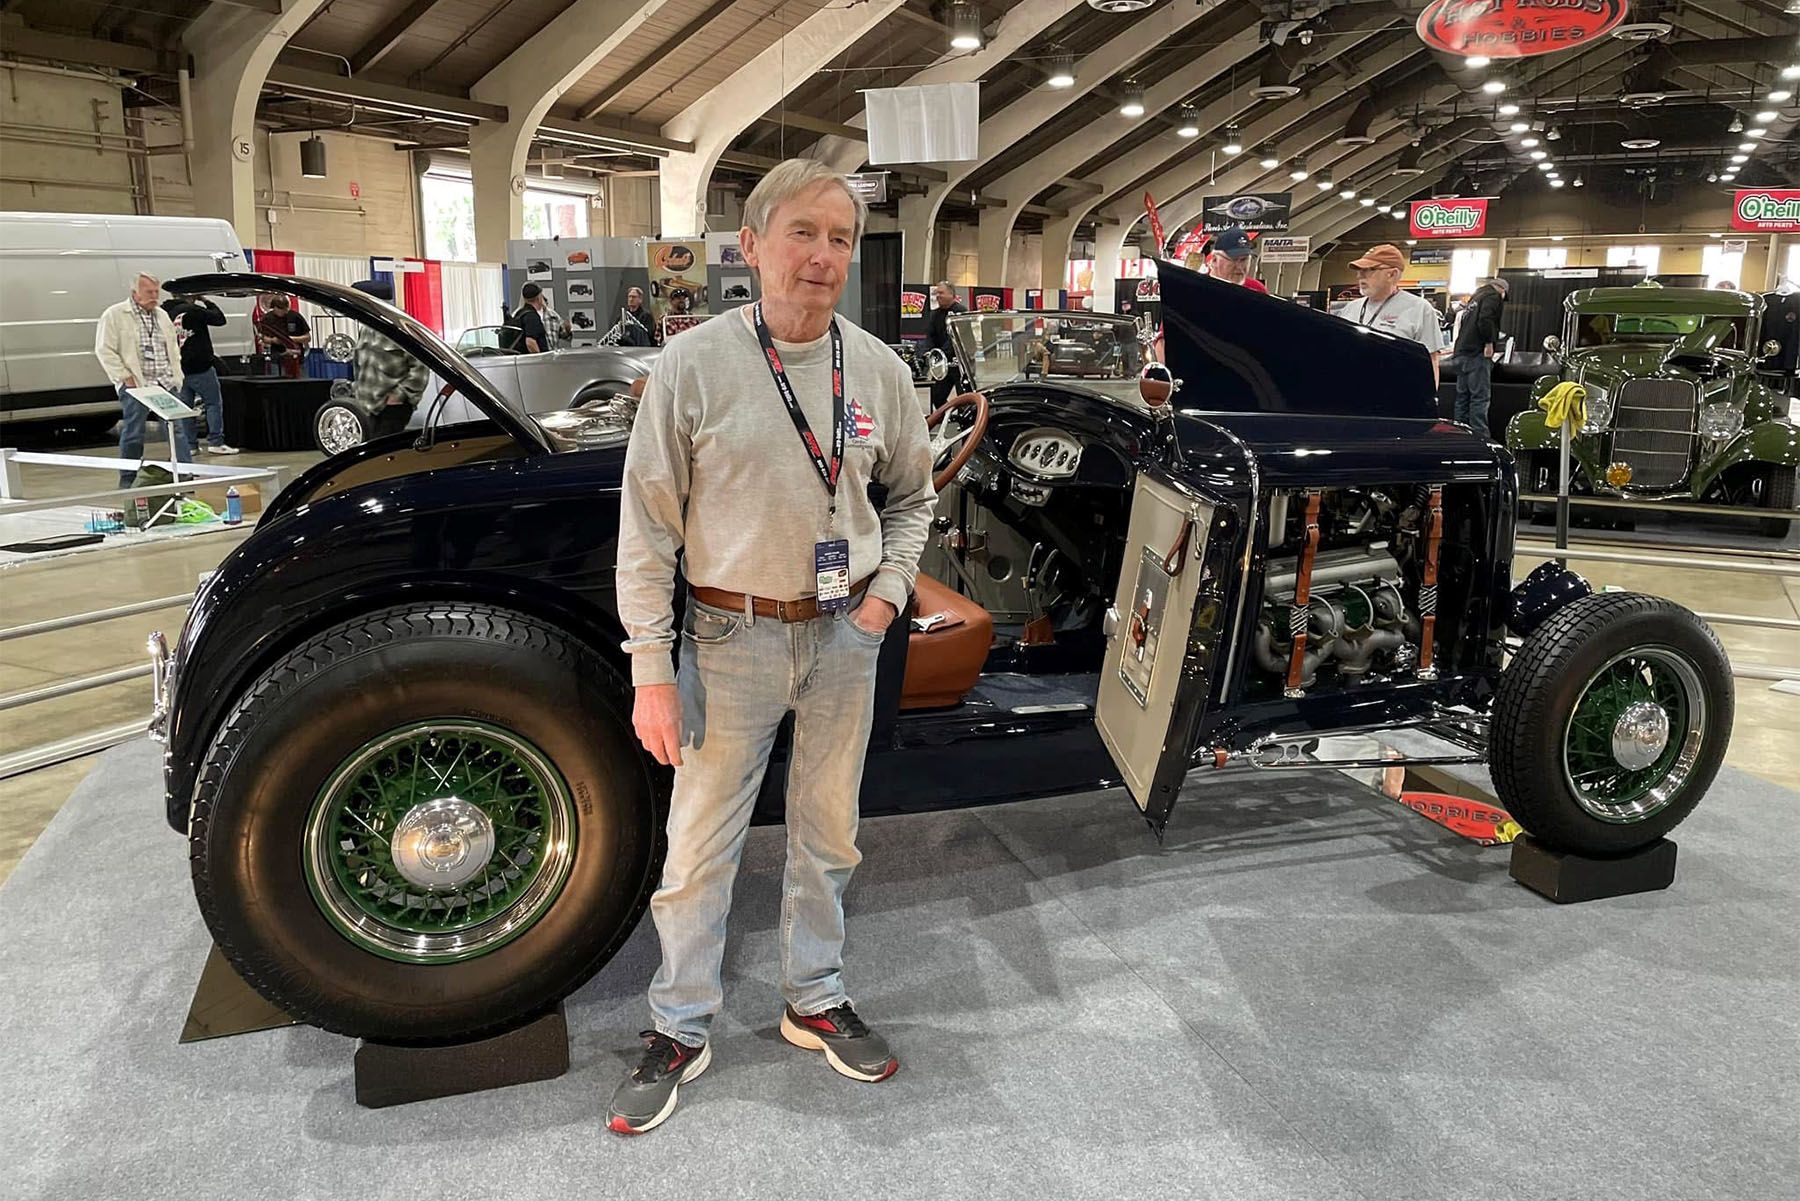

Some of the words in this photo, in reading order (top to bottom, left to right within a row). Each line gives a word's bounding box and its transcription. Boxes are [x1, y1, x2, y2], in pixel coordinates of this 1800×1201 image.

[1463, 26, 1584, 46] HOBBIES
[239, 142, 249, 154] 15
[1418, 207, 1477, 226] O'Reilly
[1742, 197, 1800, 218] O'Reill
